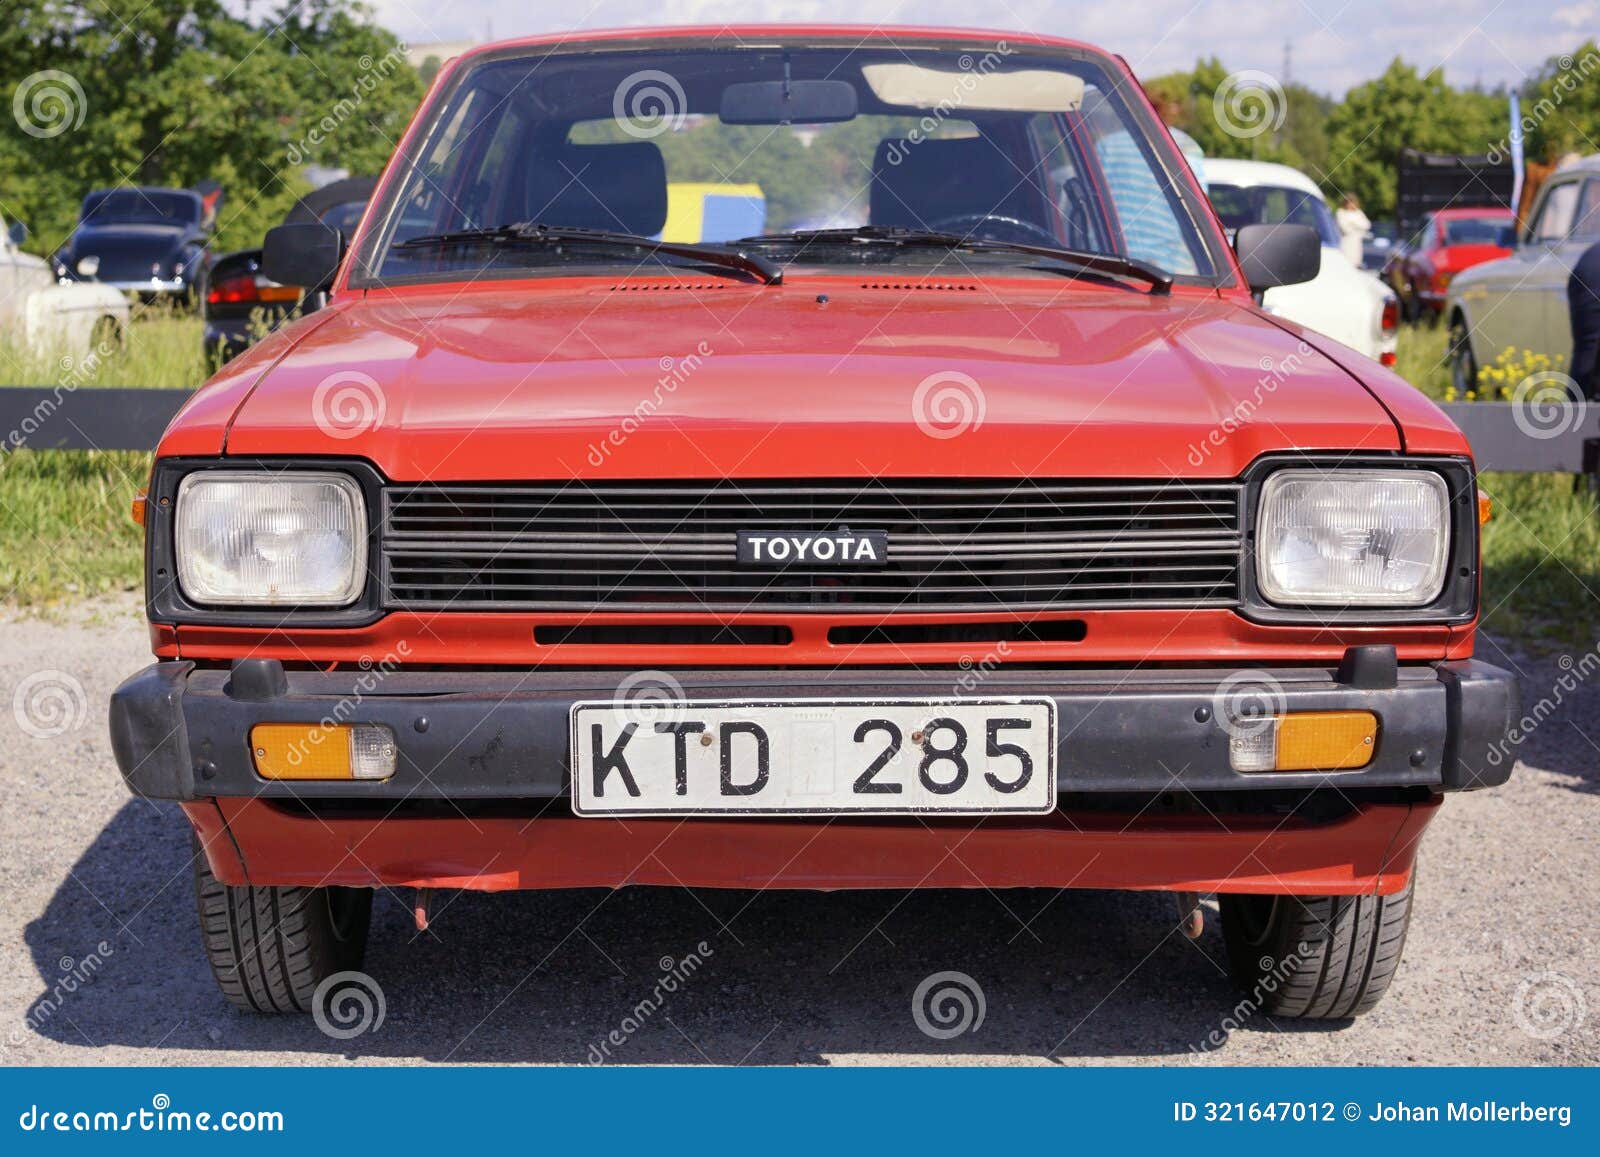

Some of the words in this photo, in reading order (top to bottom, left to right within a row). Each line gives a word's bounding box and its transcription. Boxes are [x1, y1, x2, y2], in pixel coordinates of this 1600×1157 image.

[748, 537, 877, 560] TOYOTA
[591, 721, 770, 798] KTD
[852, 717, 1034, 796] 285
